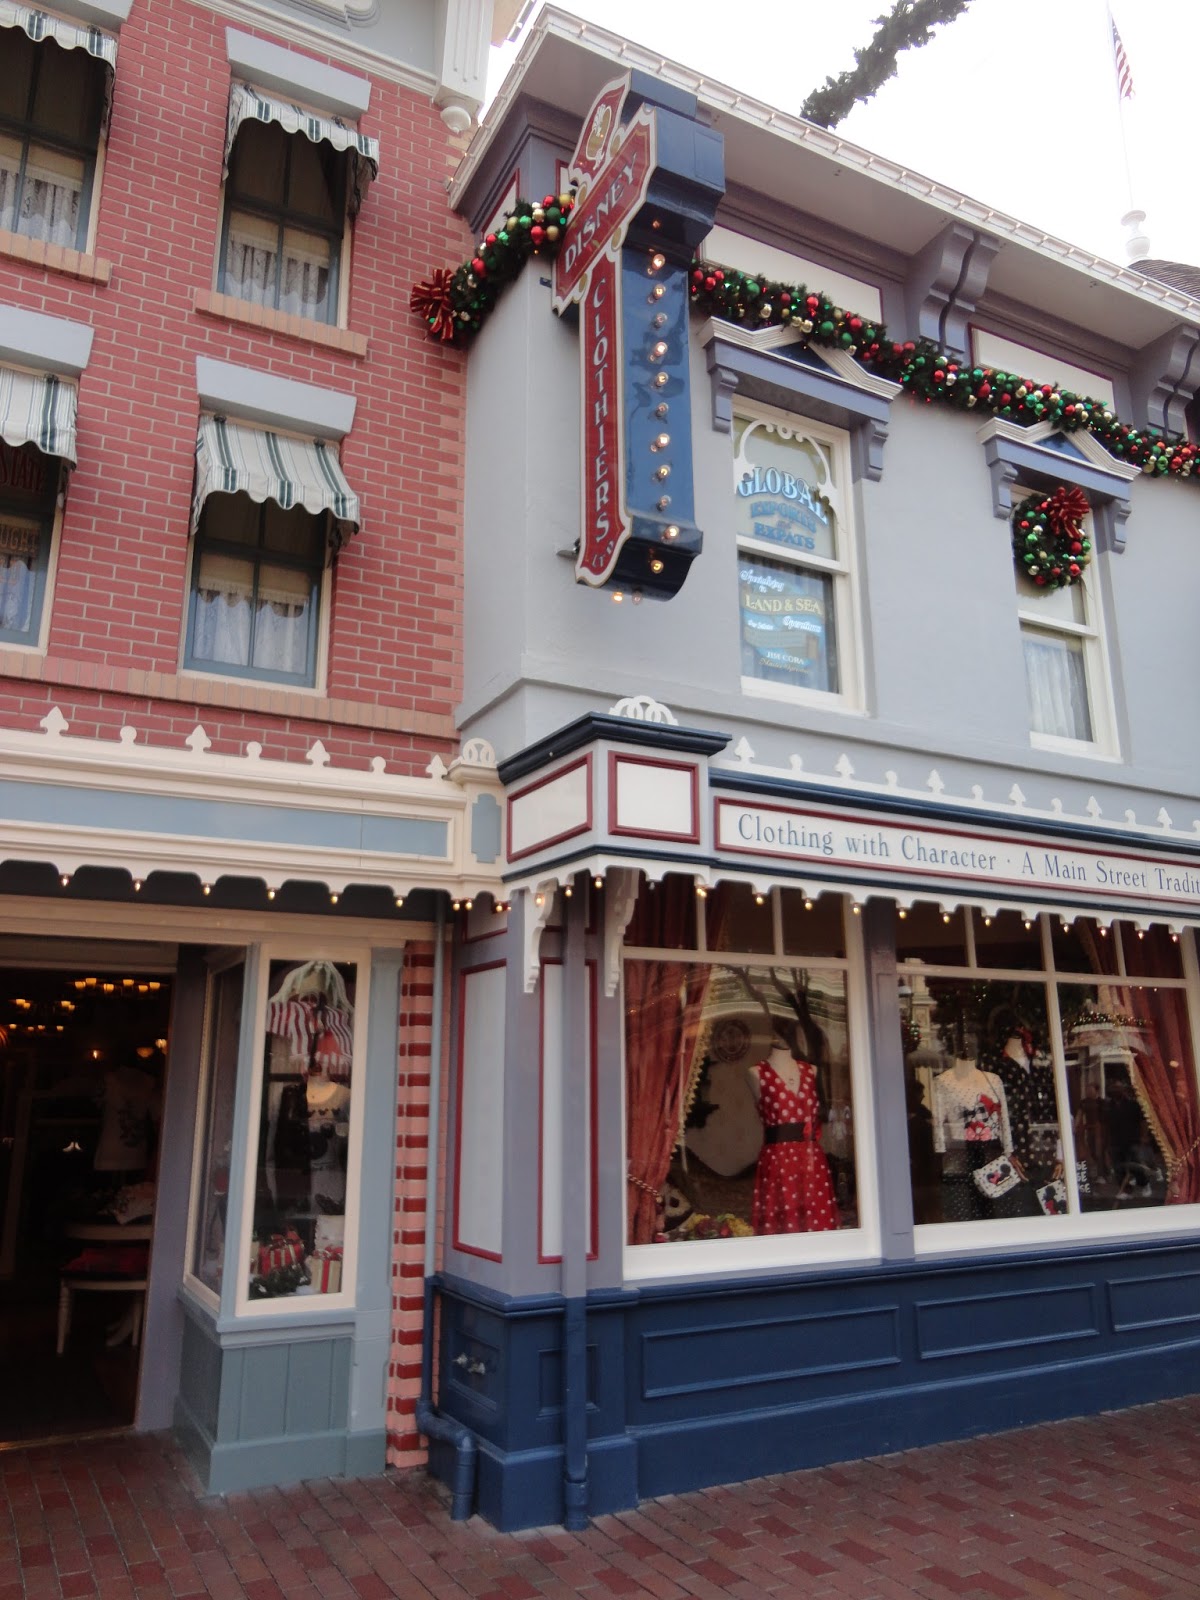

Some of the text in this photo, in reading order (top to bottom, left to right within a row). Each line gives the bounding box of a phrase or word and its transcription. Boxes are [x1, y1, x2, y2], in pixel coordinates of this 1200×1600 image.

[564, 152, 638, 273] DISNEY
[593, 278, 611, 543] CLOTHIERS
[737, 466, 828, 526] GLOBAL
[753, 522, 816, 550] EXPATS
[745, 594, 823, 615] LAND & SEA
[738, 813, 834, 856] Clothing
[845, 832, 890, 857] with
[901, 834, 996, 871] Character
[1021, 851, 1035, 875] A
[1044, 853, 1087, 881] Main
[1096, 860, 1147, 888] Street
